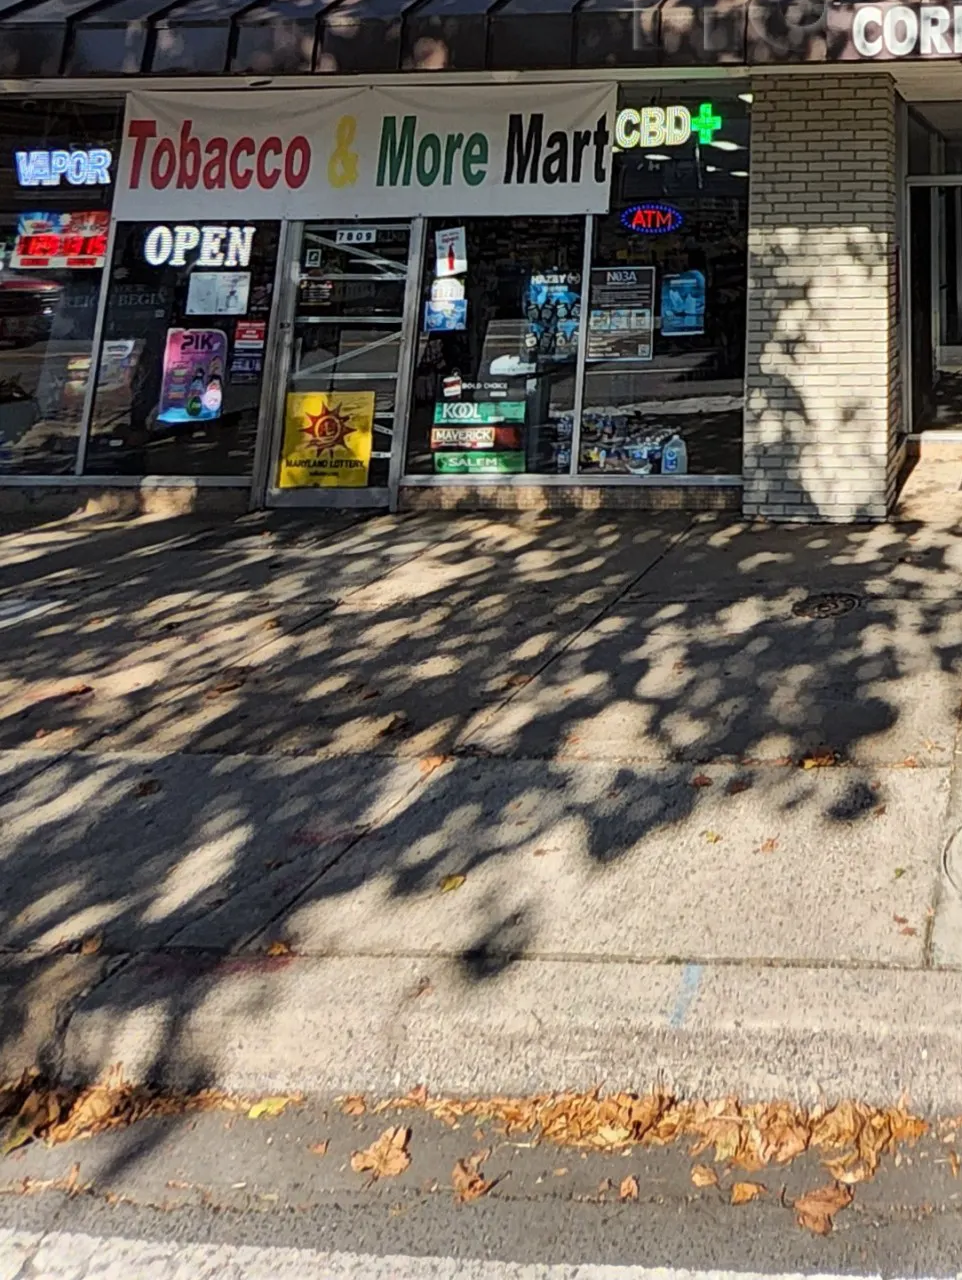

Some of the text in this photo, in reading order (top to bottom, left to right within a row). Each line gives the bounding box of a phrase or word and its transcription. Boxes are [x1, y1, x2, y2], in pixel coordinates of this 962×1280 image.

[128, 111, 610, 190] Tobacco & More Mart
[15, 149, 112, 186] VAPOR
[632, 209, 672, 229] ATM
[338, 232, 372, 241] 7809
[144, 225, 257, 267] OPEN
[442, 402, 482, 419] KOOL
[436, 429, 492, 441] MAVERICK
[286, 460, 364, 469] MARYLAND LOTTERY
[449, 457, 498, 467] SALEM
